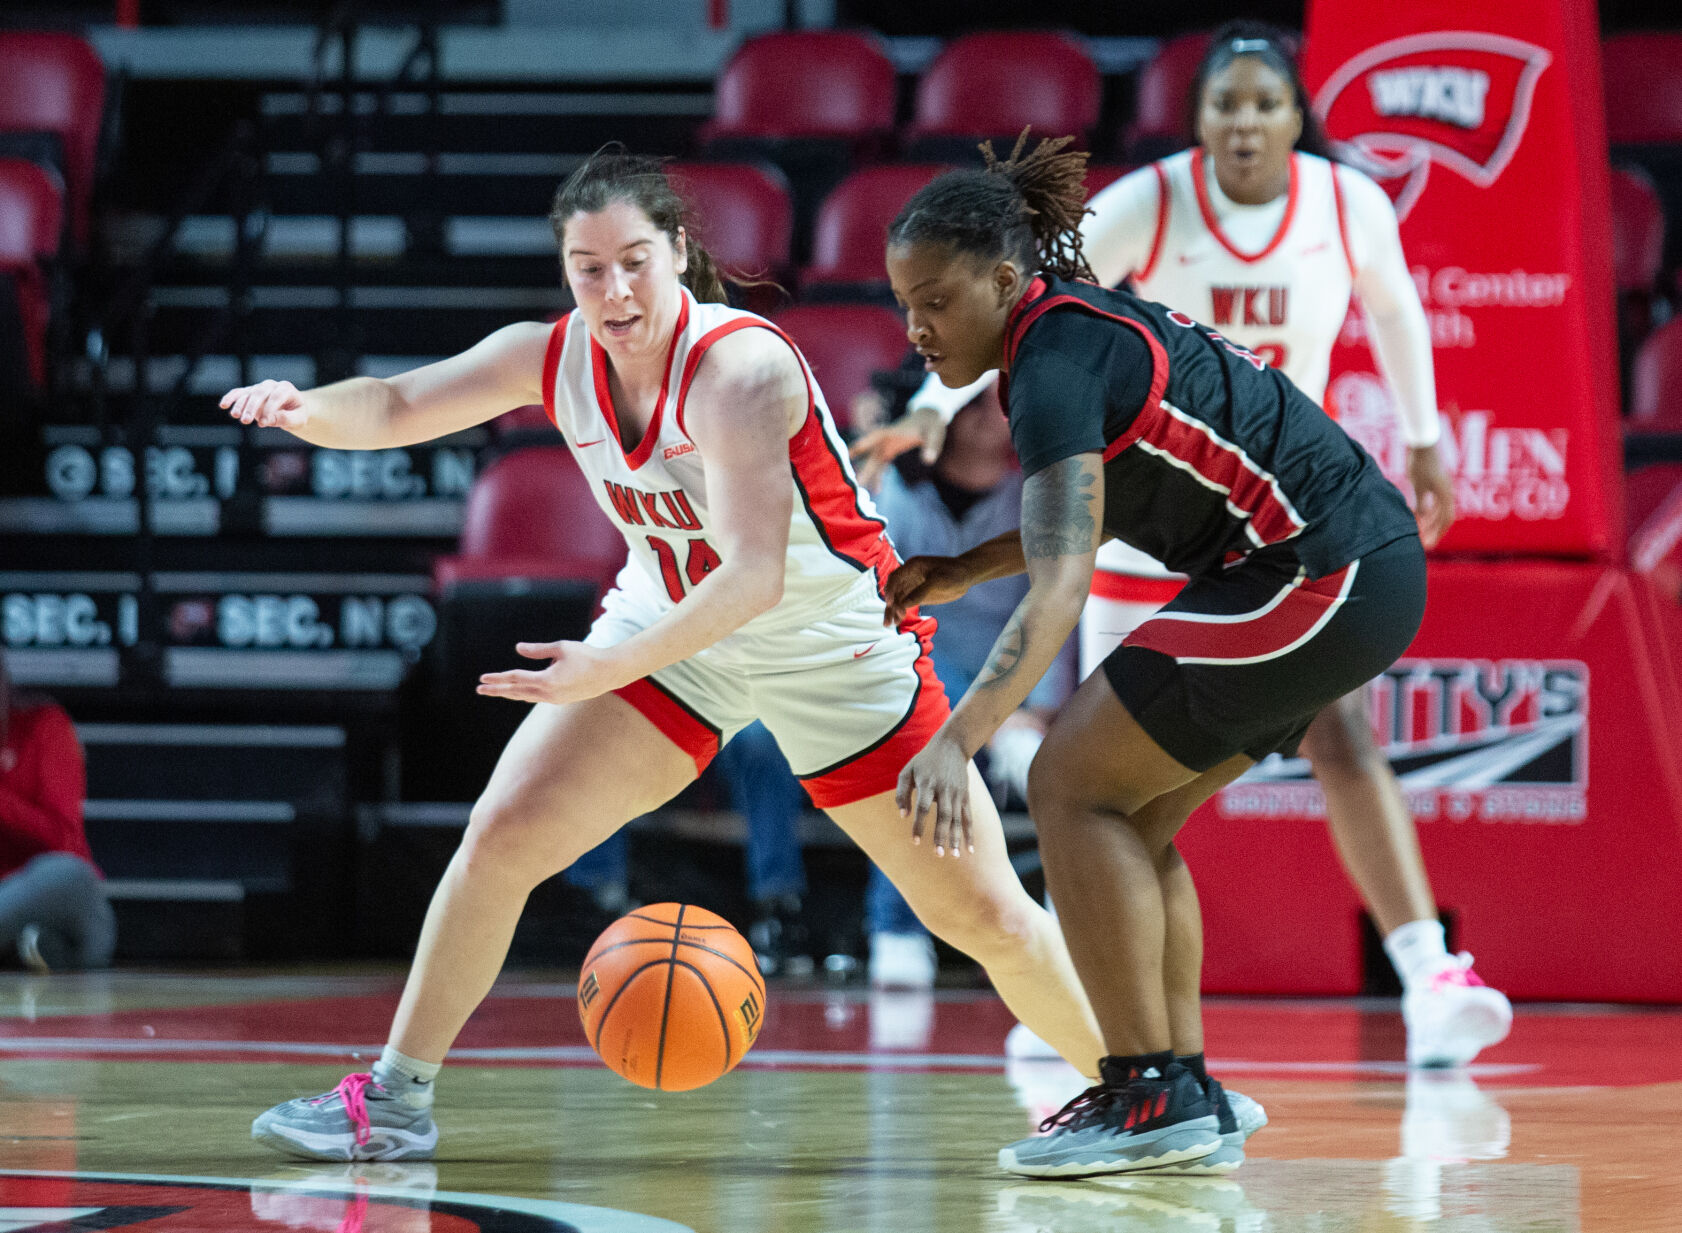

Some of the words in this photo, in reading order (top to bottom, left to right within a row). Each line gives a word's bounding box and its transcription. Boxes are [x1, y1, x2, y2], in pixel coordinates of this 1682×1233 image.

[1368, 67, 1488, 129] WKU
[1210, 286, 1288, 326] WKU
[1433, 267, 1569, 307] Center
[603, 479, 703, 530] WKU
